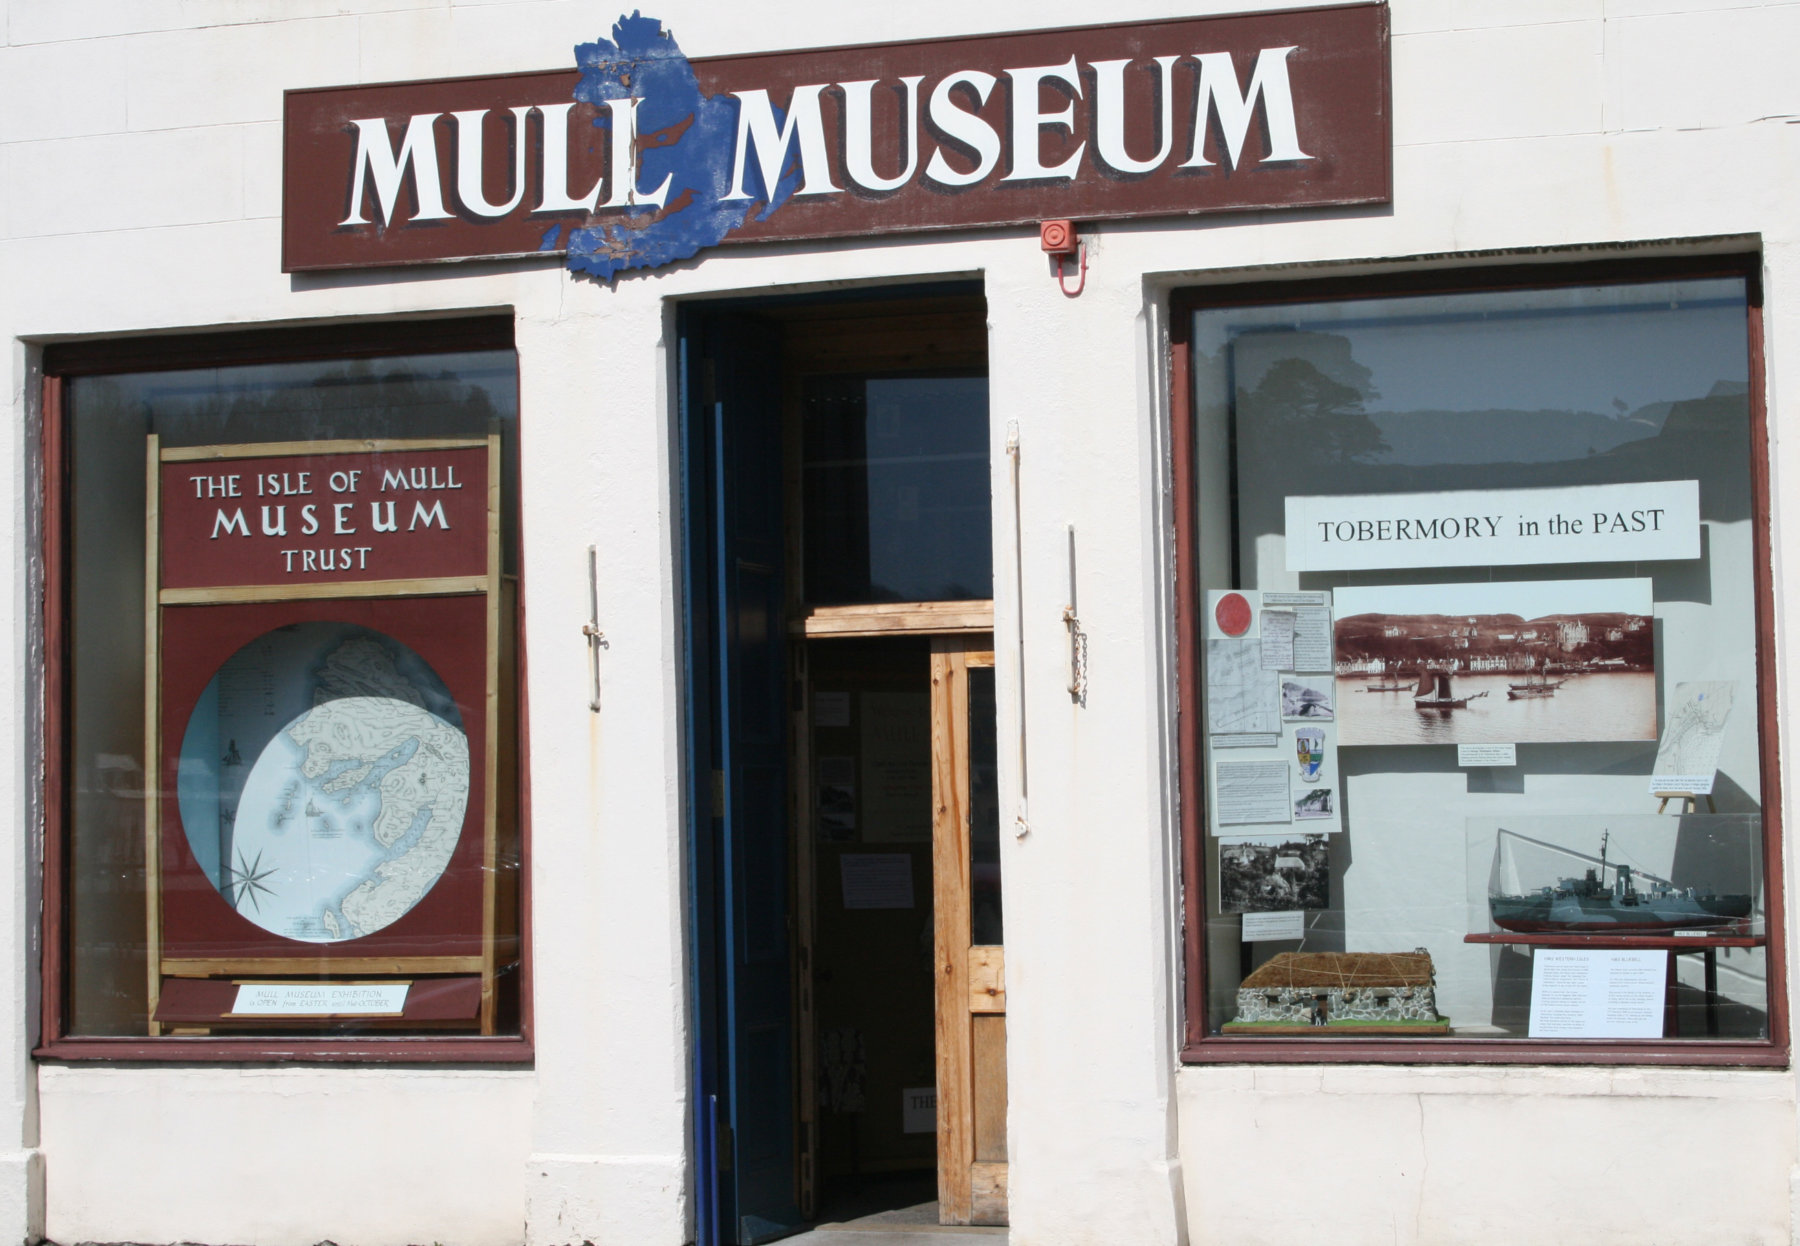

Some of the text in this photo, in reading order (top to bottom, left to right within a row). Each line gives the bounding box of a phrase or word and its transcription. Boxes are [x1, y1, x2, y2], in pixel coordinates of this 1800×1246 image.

[338, 45, 1315, 229] MULL MUSEUM
[189, 466, 463, 499] THE ISLE OF MULL
[210, 500, 451, 540] MUSEUM
[1317, 508, 1666, 543] TOBERMORY in the PAST
[281, 547, 372, 573] TRUST
[255, 990, 383, 999] MULL MUSEUM EXHIBITION
[256, 999, 278, 1007] OPEN
